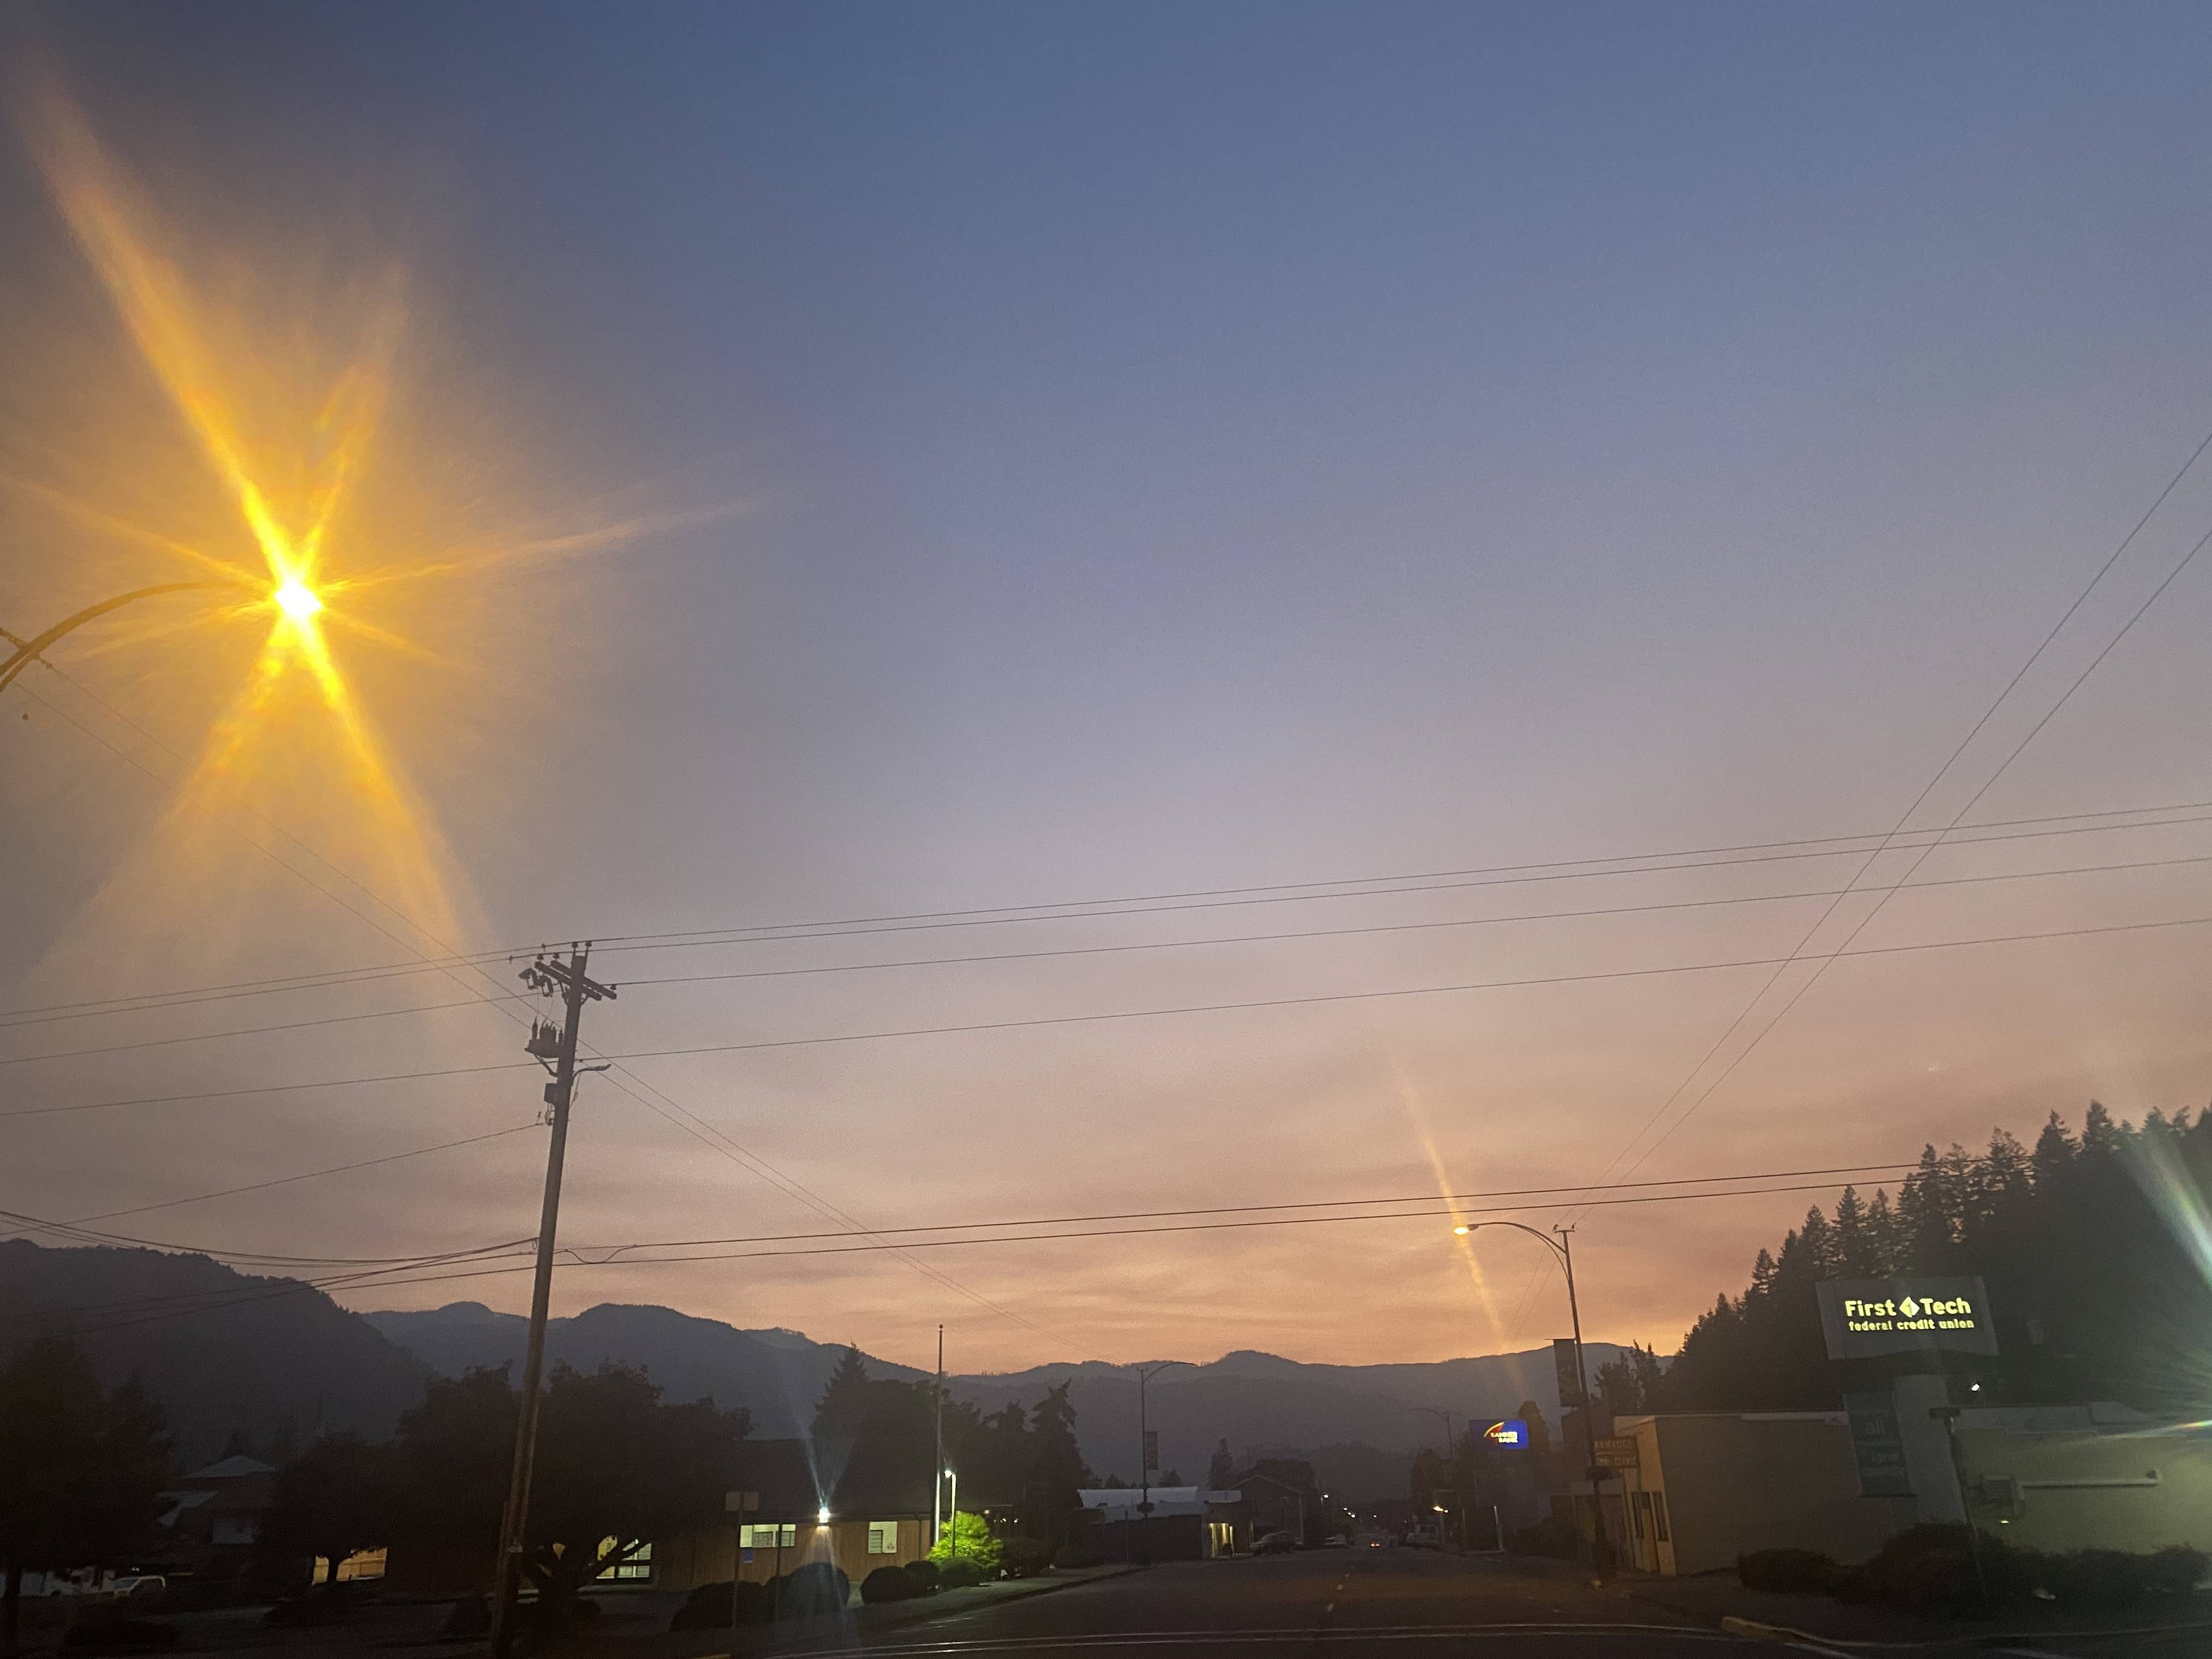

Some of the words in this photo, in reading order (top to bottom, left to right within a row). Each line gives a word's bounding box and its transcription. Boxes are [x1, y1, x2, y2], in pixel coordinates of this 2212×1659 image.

[1845, 1299, 1897, 1317] First
[1919, 1297, 1971, 1315] Tech
[1849, 1320, 1893, 1331] federal
[1896, 1319, 1936, 1330] credit
[1938, 1319, 1975, 1330] union
